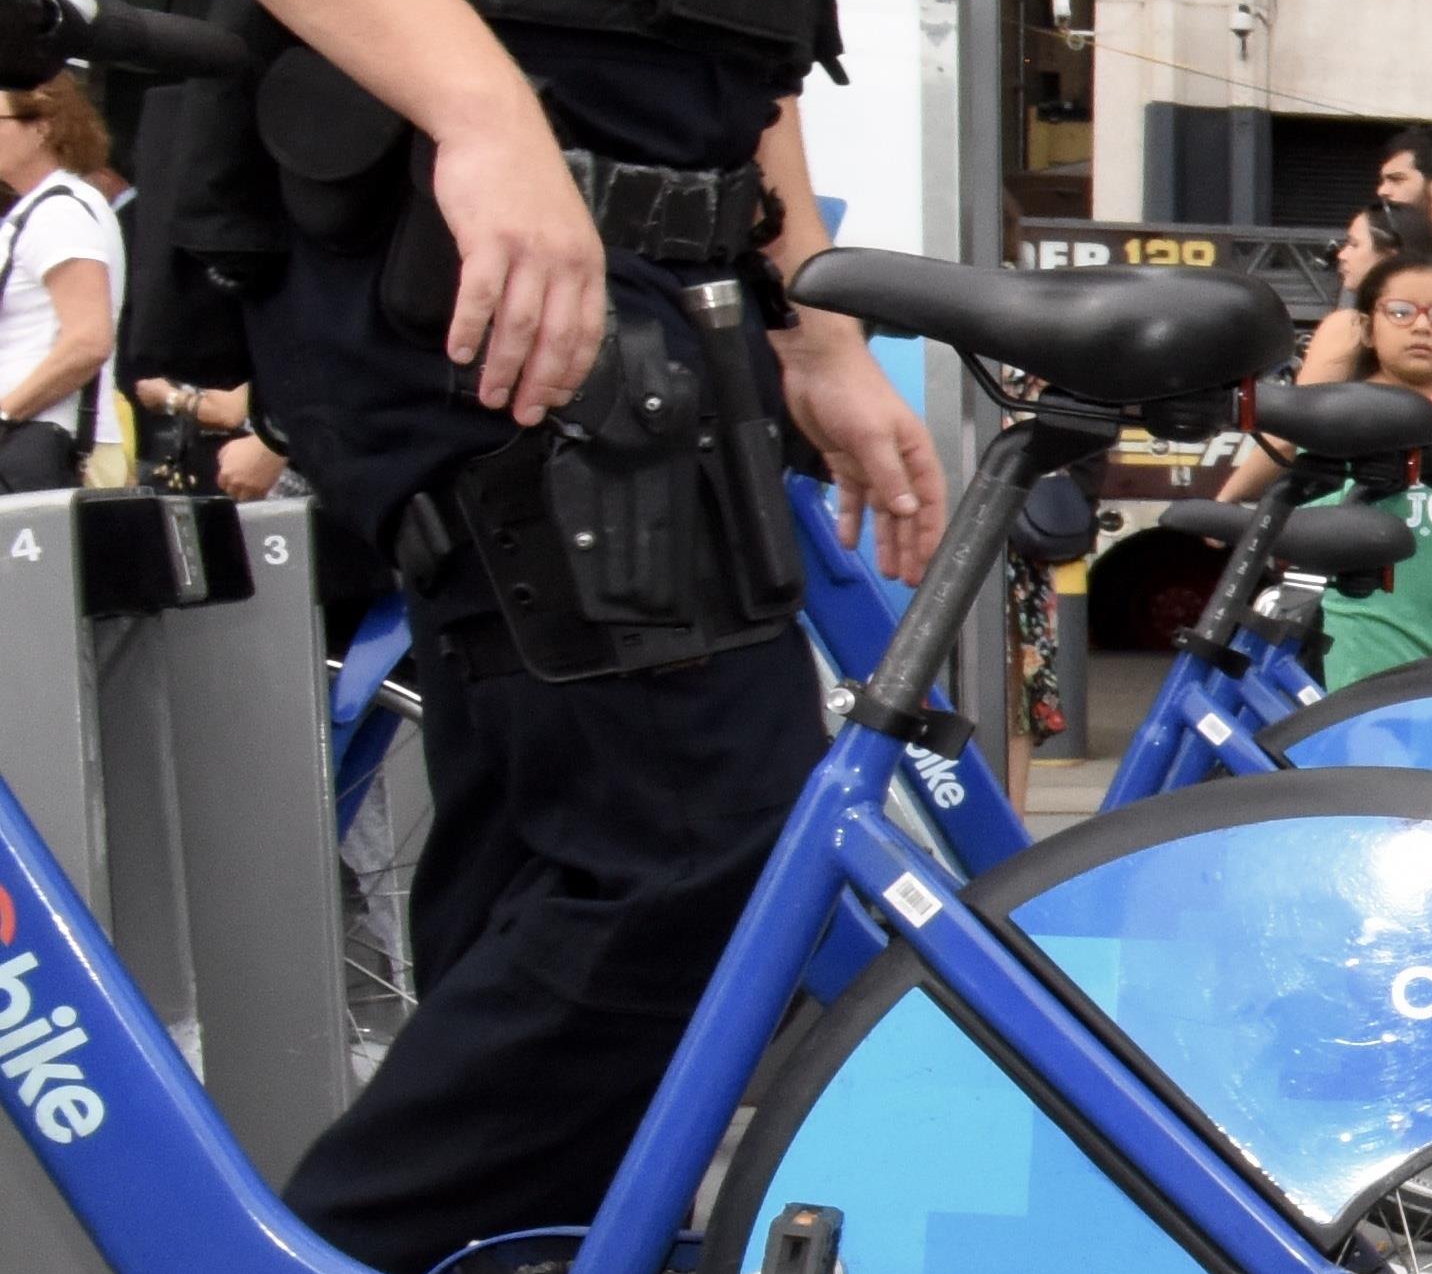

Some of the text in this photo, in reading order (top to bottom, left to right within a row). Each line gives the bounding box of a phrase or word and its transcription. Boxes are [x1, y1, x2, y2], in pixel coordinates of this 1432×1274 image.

[11, 528, 41, 561] 4
[264, 535, 289, 565] 3
[0, 951, 104, 1144] bike
